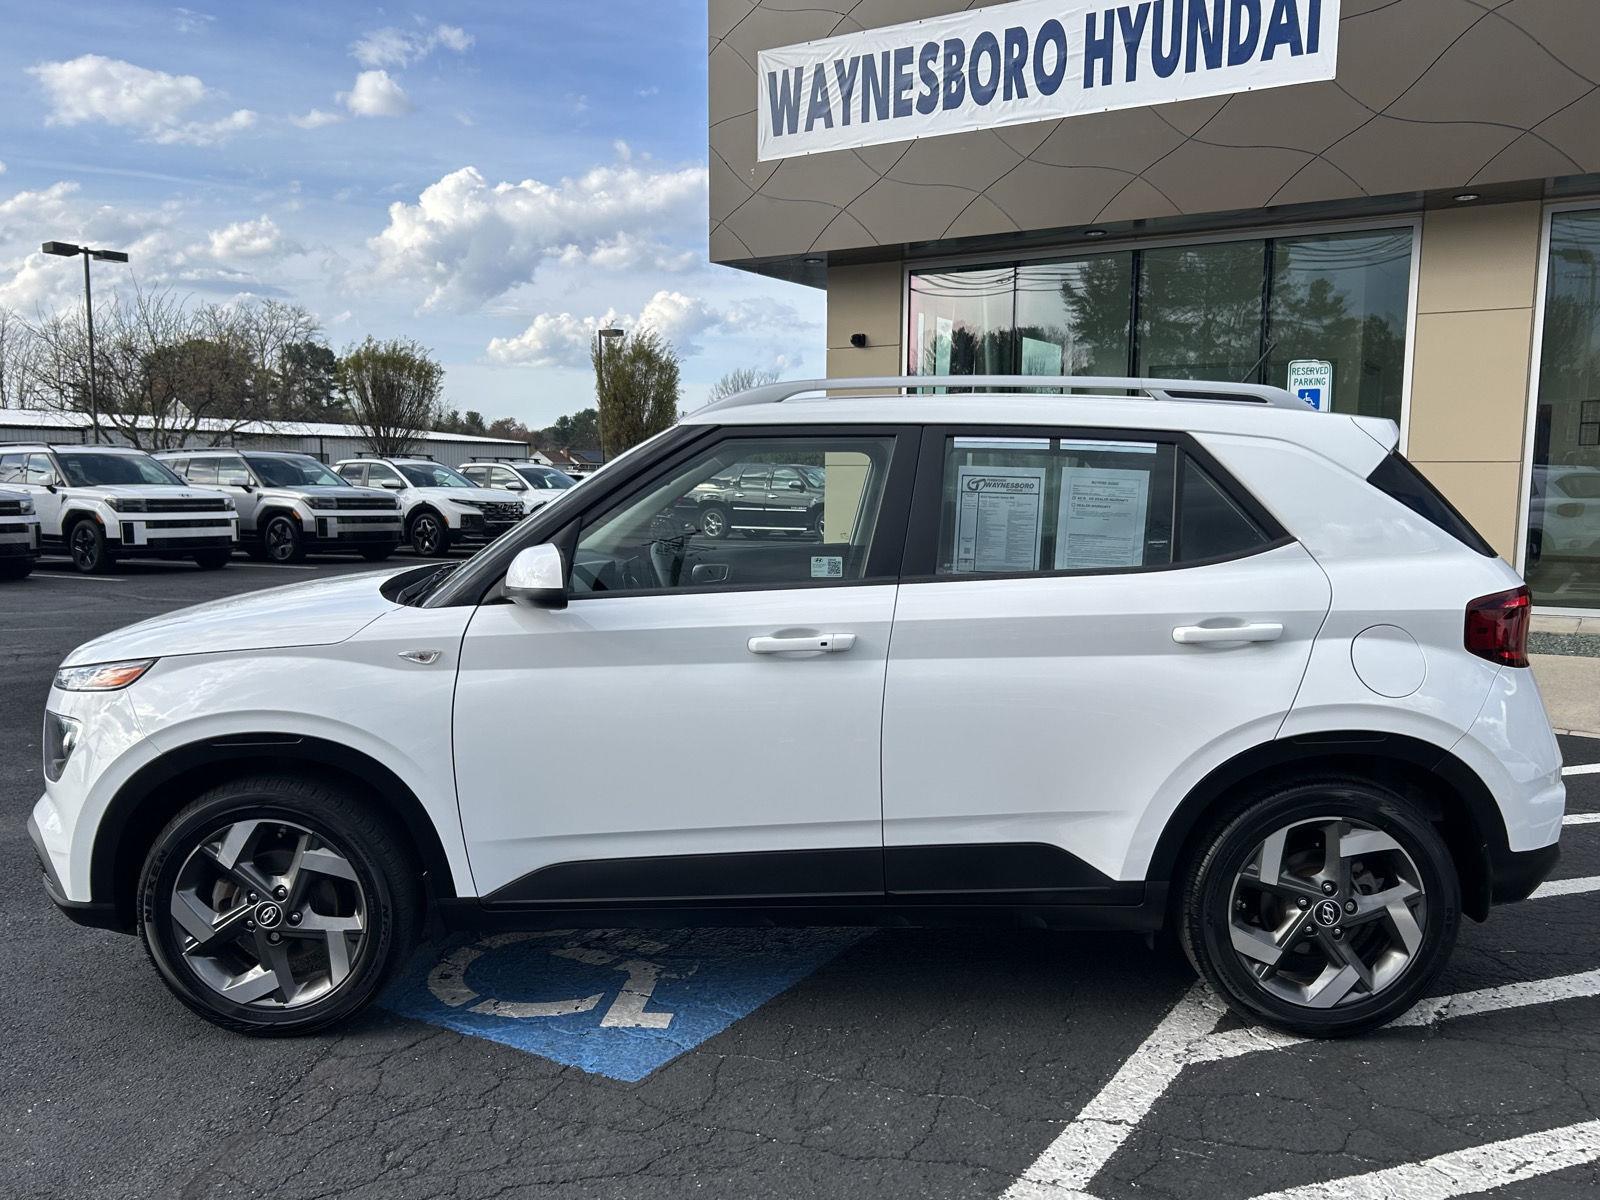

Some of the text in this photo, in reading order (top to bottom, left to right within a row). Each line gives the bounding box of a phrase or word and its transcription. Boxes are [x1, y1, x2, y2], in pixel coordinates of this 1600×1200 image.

[768, 0, 1322, 137] WAYNESBORO HYUNDAI
[1291, 366, 1329, 376] RESERVED
[1293, 377, 1326, 386] PARKING
[145, 848, 167, 923] NEXEN
